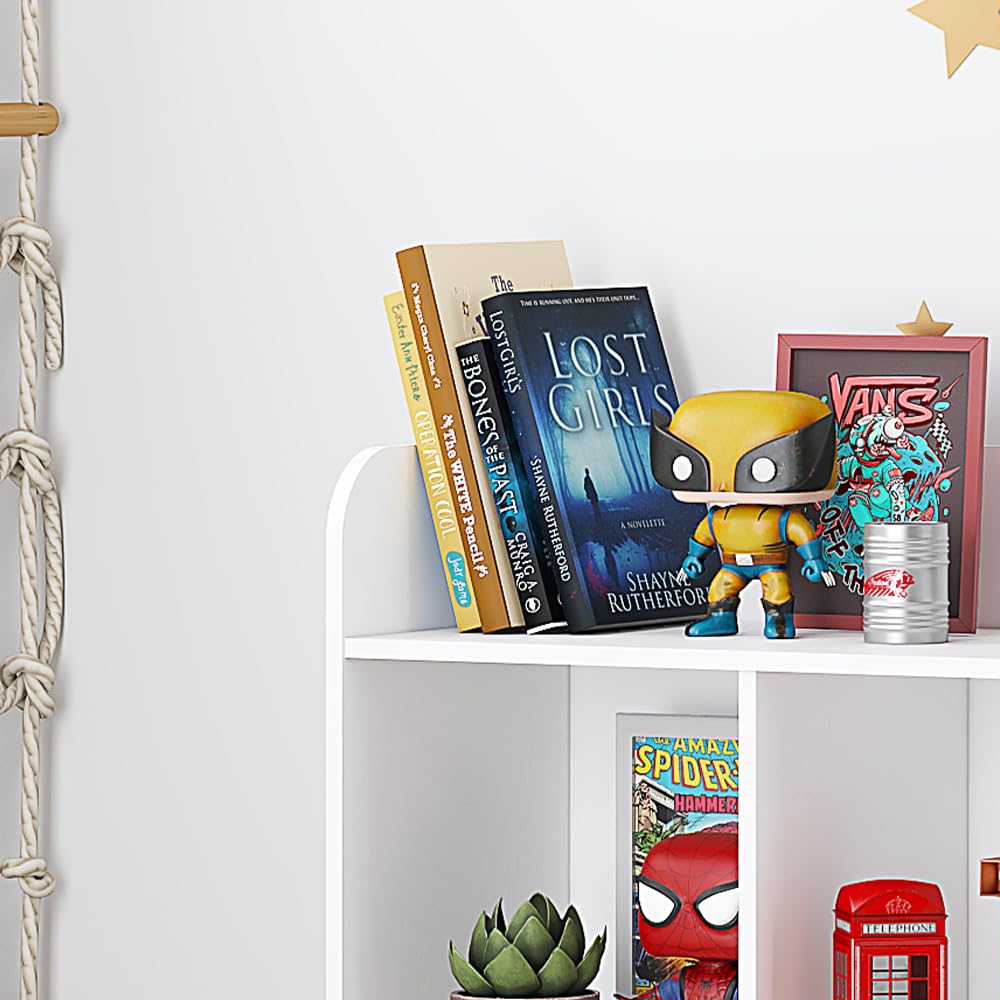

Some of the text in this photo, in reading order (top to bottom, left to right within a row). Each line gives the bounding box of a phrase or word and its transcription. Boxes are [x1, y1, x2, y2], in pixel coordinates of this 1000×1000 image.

[491, 275, 514, 292] The
[412, 294, 424, 325] Megan
[420, 325, 432, 354] Cheryl
[461, 354, 480, 367] THE
[489, 311, 523, 394] LOST GIRLS
[543, 331, 649, 379] LOST
[464, 364, 499, 448] BONES
[549, 383, 674, 432] GIRLS
[829, 372, 940, 430] VANS
[486, 444, 499, 455] OF
[486, 452, 505, 463] THE
[415, 411, 457, 540] OPERATION COOL
[442, 429, 484, 565] The WHITE Pencil
[489, 463, 518, 515] PAST
[530, 457, 550, 503] SHAYNE
[543, 505, 571, 582] RUTHERFORD
[626, 518, 666, 529] NOVELETTE
[821, 506, 849, 557] OFF
[506, 538, 528, 592] MUNRO
[514, 531, 535, 576] CRAIG
[607, 587, 709, 613] RUTHERFOR
[842, 563, 865, 596] TH
[635, 744, 738, 792] SPIDER-
[674, 793, 738, 813] HAMMER
[866, 923, 937, 934] TELEPHONE
